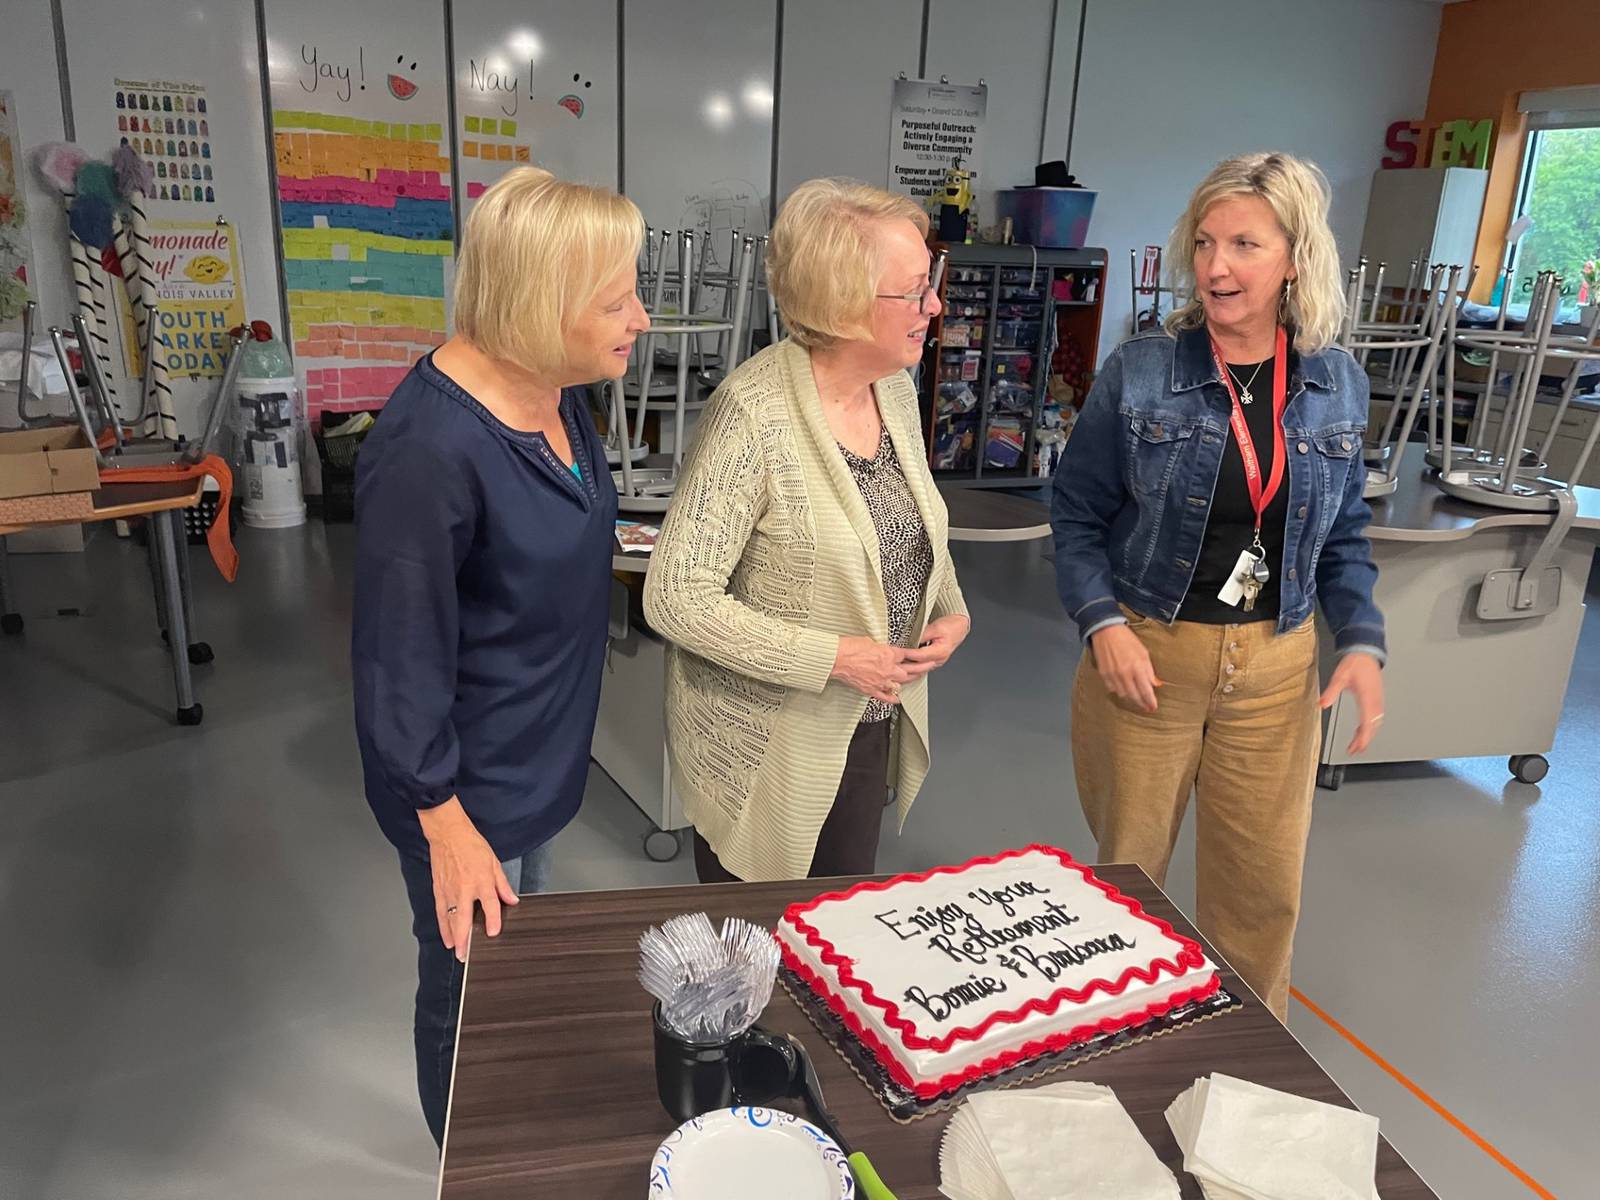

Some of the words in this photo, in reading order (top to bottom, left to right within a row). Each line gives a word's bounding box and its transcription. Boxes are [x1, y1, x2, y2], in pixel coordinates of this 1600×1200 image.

[300, 44, 367, 102] Yay!
[469, 58, 535, 117] Nay!
[902, 120, 940, 132] Purposeful
[942, 123, 976, 133] Outreach:
[904, 131, 933, 141] Actively
[935, 133, 967, 144] Engaging
[968, 135, 973, 143] a
[1381, 118, 1494, 169] STEM
[903, 141, 930, 152] Diverse
[932, 143, 973, 155] Community
[895, 166, 926, 176] Empower
[928, 167, 941, 176] and
[900, 176, 931, 186] Students
[910, 187, 932, 196] Global
[149, 230, 228, 250] monade
[189, 288, 234, 299] VALLEY
[159, 310, 226, 329] OUTH
[160, 331, 230, 350] ARKE
[167, 352, 229, 371] ODAY
[874, 903, 983, 941] Enjoy
[928, 900, 1079, 964] Retirement
[904, 974, 1007, 1022] Bonnie
[1010, 933, 1137, 982] Barbara
